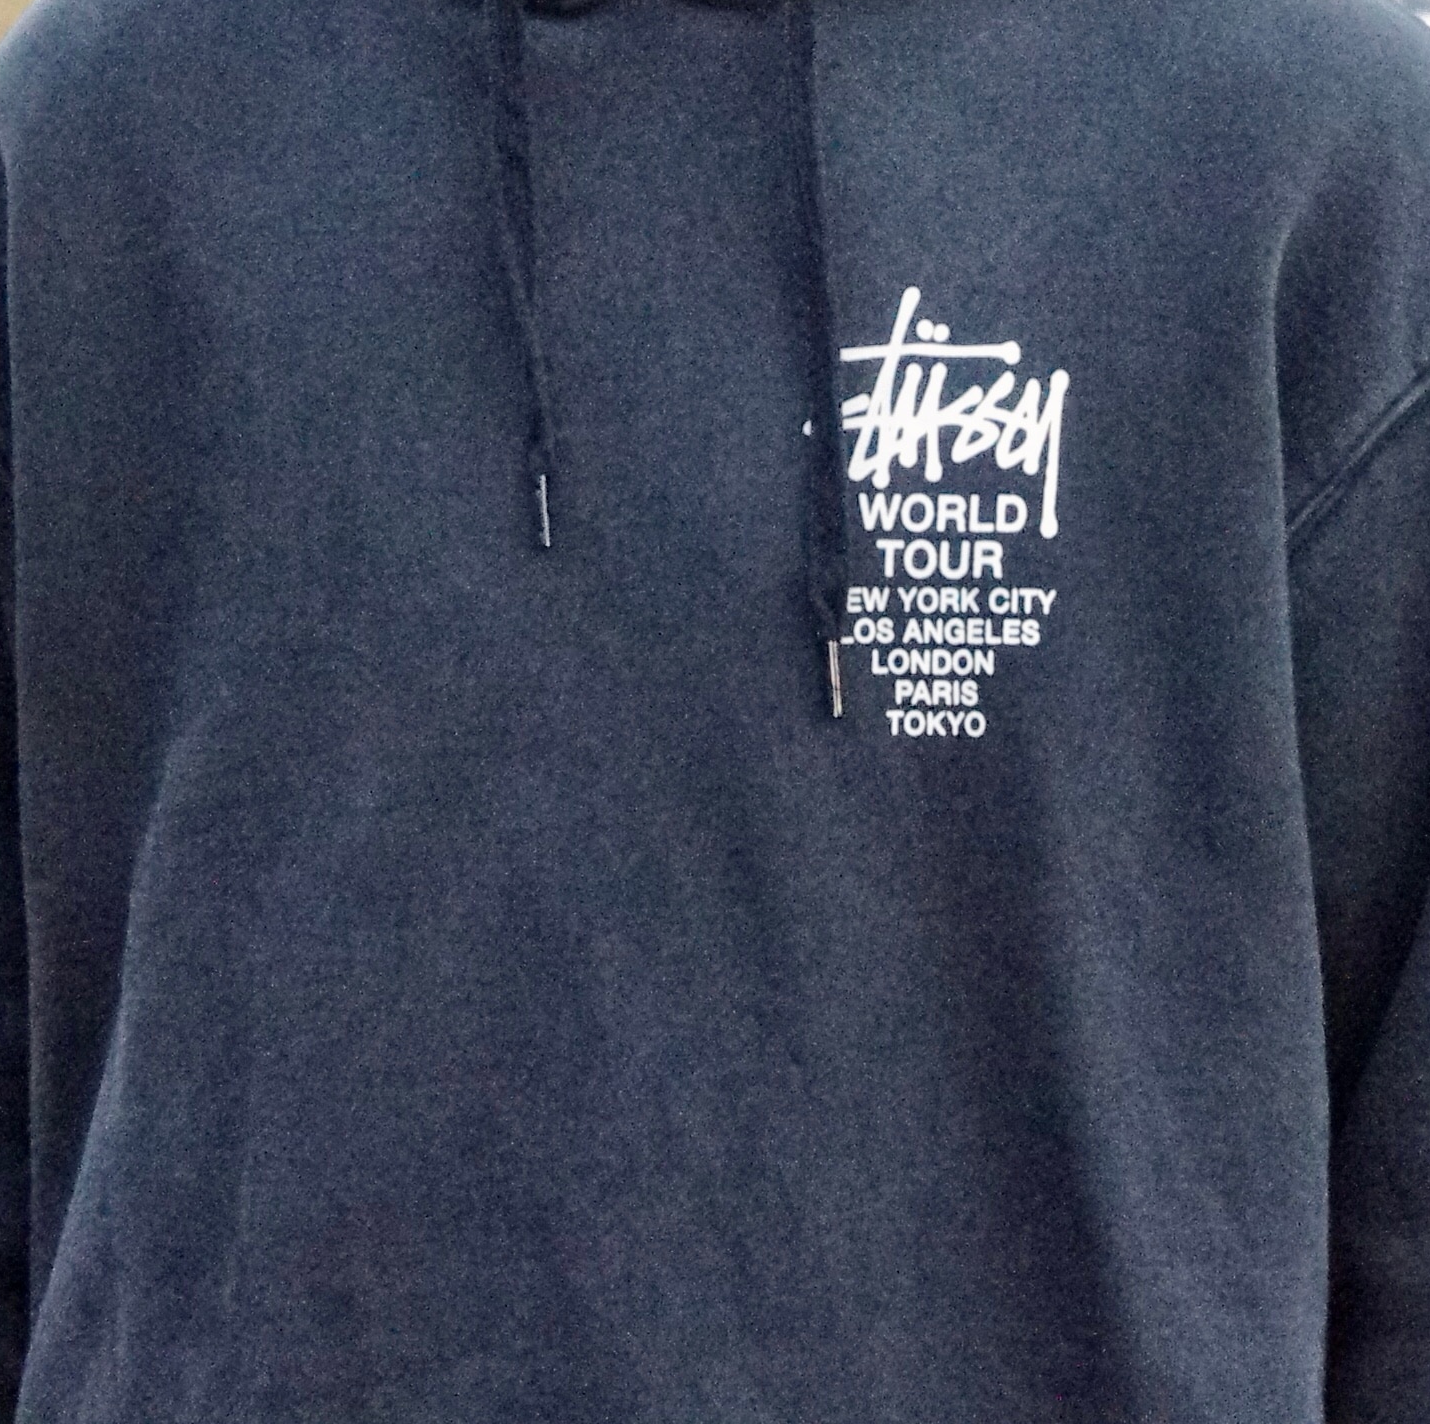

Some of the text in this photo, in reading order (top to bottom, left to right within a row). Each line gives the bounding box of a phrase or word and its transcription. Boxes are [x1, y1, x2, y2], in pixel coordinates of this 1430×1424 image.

[859, 492, 1028, 533] WORLD
[876, 539, 1004, 579] TOUR
[846, 586, 1057, 616] EW YORK CITY
[902, 617, 1041, 646] ANGELES
[871, 648, 995, 676] LONDON
[894, 679, 979, 707] PARIS
[885, 709, 987, 738] TOKYO
